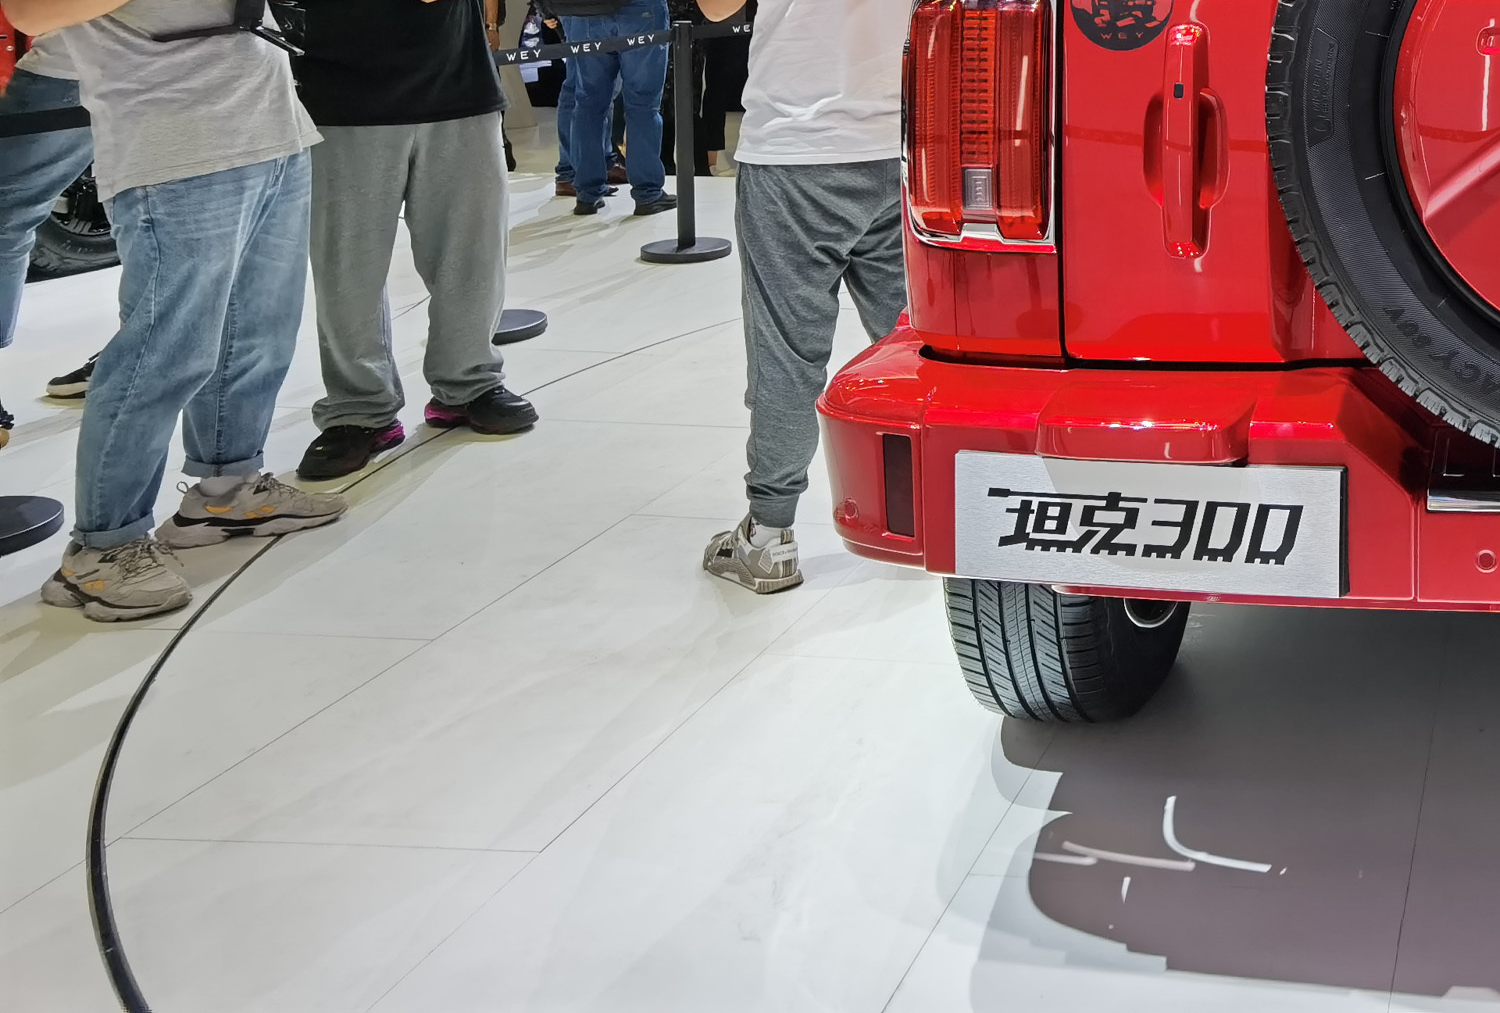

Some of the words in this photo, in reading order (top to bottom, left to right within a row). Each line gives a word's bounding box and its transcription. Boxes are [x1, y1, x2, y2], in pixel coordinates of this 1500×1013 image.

[506, 49, 541, 61] WEY
[571, 42, 602, 54] WEY
[627, 34, 655, 46] WEY
[987, 487, 1304, 565] 坦克300
